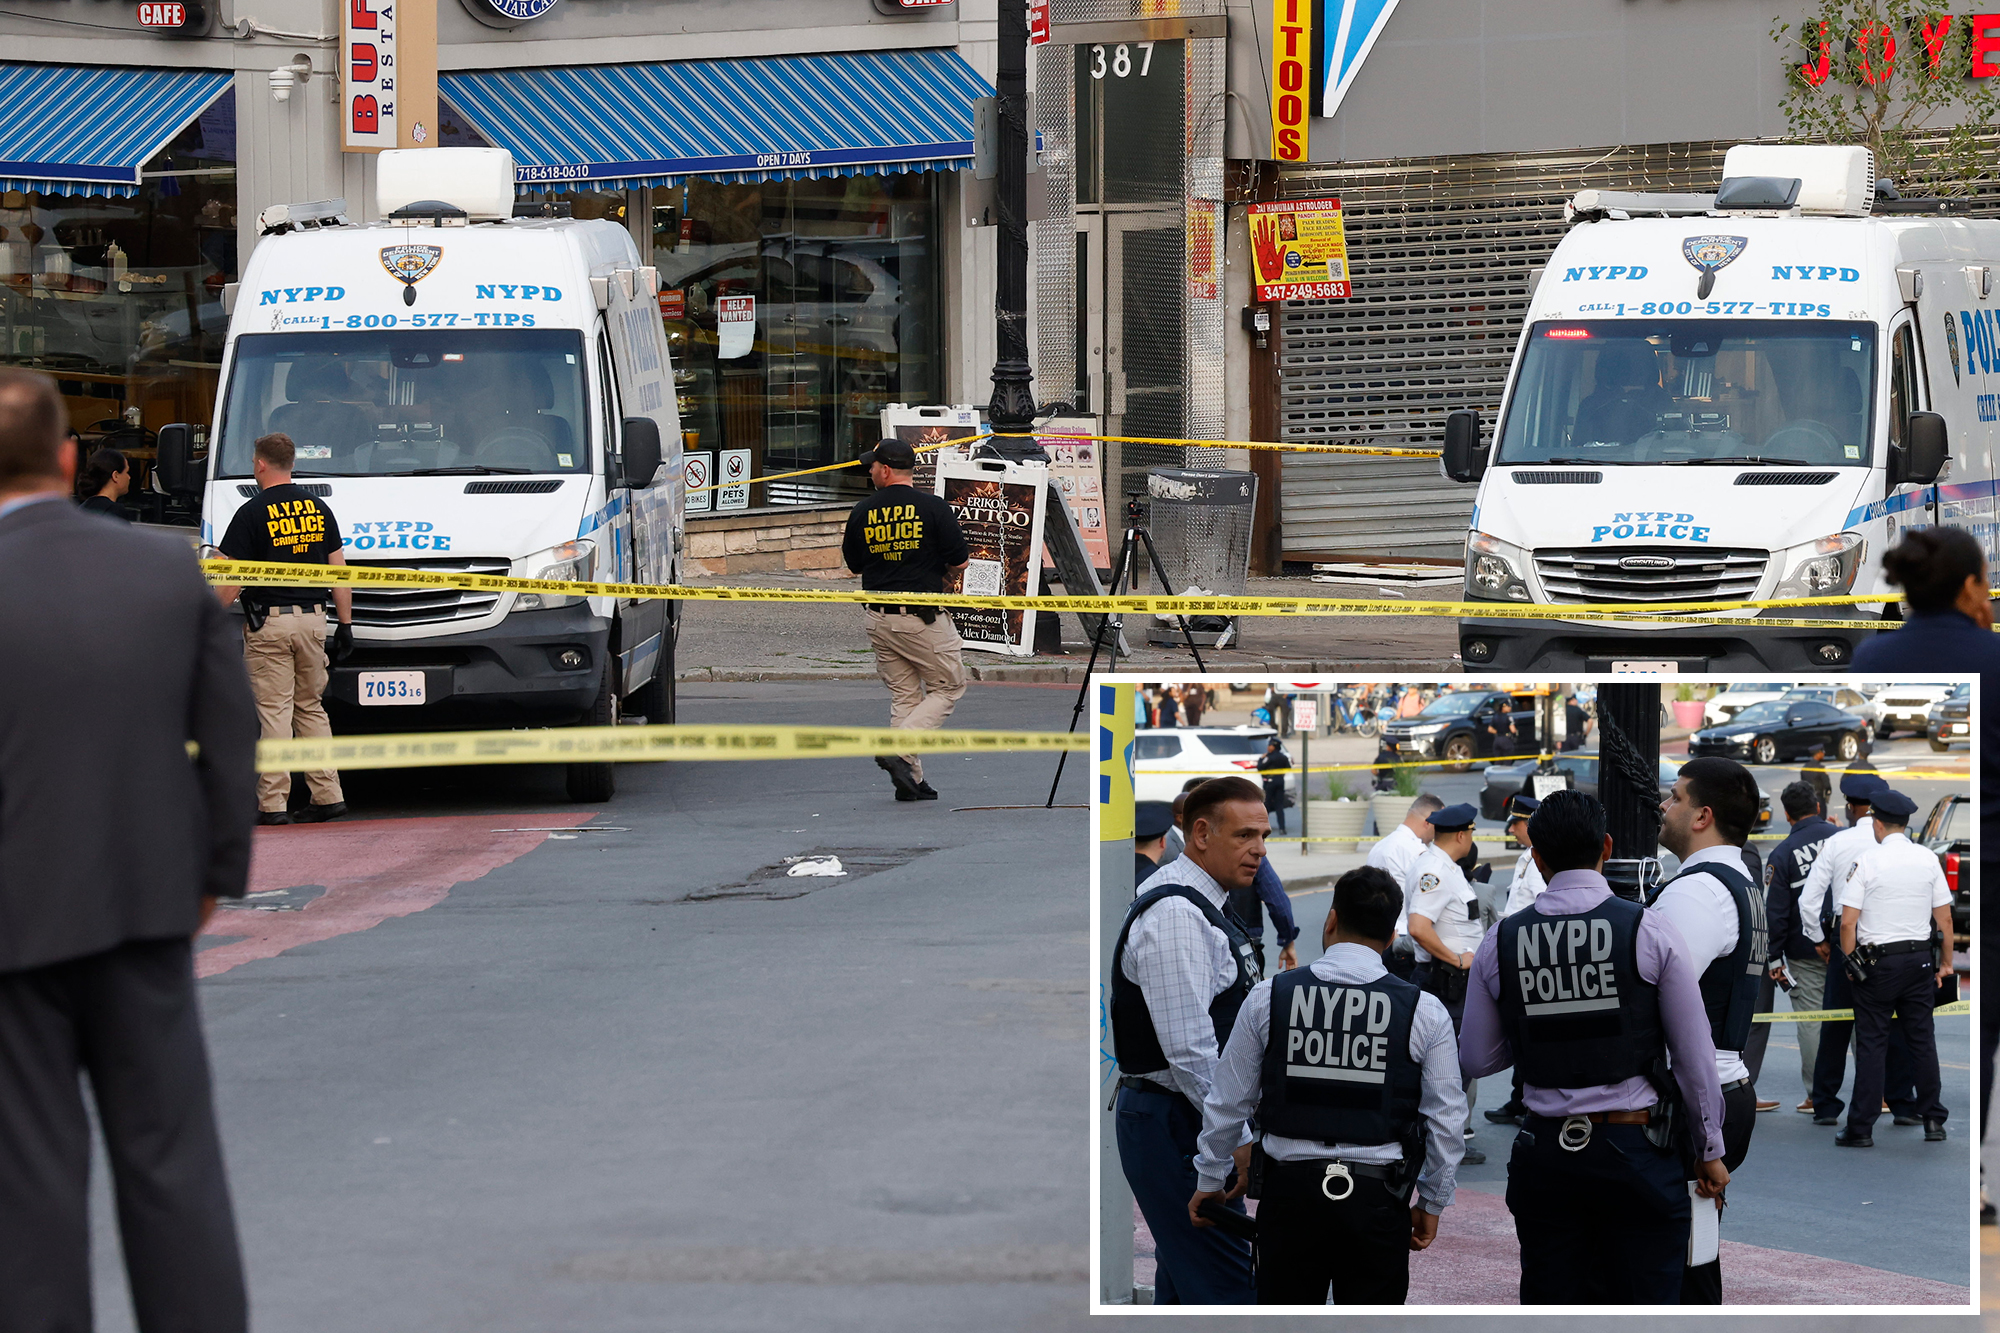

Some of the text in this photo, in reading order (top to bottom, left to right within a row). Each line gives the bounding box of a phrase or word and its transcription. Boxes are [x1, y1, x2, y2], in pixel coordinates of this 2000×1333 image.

[139, 4, 182, 25] CAFE
[381, 5, 394, 117] RESTA
[1090, 41, 1155, 79] 387
[757, 152, 811, 167] OPEN 7 DAYS
[518, 165, 589, 181] 718-618-0610
[1266, 202, 1295, 213] HANUMAN
[1296, 200, 1333, 211] ASTROLOGER
[1686, 238, 1743, 246] DEPARTMENT
[383, 249, 440, 257] DEPARTMENT
[1564, 266, 1648, 282] NYPD
[1771, 265, 1860, 282] NYPD
[259, 286, 345, 306] NYPD
[475, 284, 562, 302] NYPD
[1264, 283, 1345, 299] 347-249-5683
[726, 299, 746, 310] HELP
[1578, 301, 1831, 318] CALL: 1-800-577-TIPS
[283, 313, 535, 329] CALL: 1-800-577-TIPS
[721, 310, 752, 322] WANTED
[727, 480, 741, 489] NO
[691, 495, 707, 504] BIKES
[722, 489, 744, 499] PETS
[266, 499, 321, 519] N.Y.P.D.
[967, 496, 1009, 510] ERIKON
[868, 504, 920, 525] N.Y.P.D.
[949, 504, 1030, 527] TATTOO
[1612, 512, 1694, 523] NYPD
[266, 515, 325, 538] POLICE
[352, 521, 433, 534] NYPD
[863, 521, 924, 544] POLICE
[1591, 523, 1710, 543] POLICE
[272, 533, 324, 547] CRIME SCENE
[341, 534, 451, 551] POLICE
[988, 531, 1007, 539] Piercg
[292, 543, 309, 555] UNIT
[868, 540, 920, 554] CRIME SCENE
[883, 551, 902, 561] UNIT
[1156, 601, 1169, 610] CROSS
[1170, 601, 1178, 610] NOT
[1178, 601, 1185, 610] DO
[1189, 601, 1202, 610] SCENE
[1202, 601, 1216, 610] CRIME
[955, 612, 1001, 624] 347-608-0021
[962, 628, 979, 639] Alex
[365, 680, 422, 697] 7053 16
[1517, 918, 1613, 969] NYPD
[1518, 962, 1618, 1003] POLICE
[1289, 985, 1392, 1035] NYPD
[1286, 1029, 1389, 1070] POLICE
